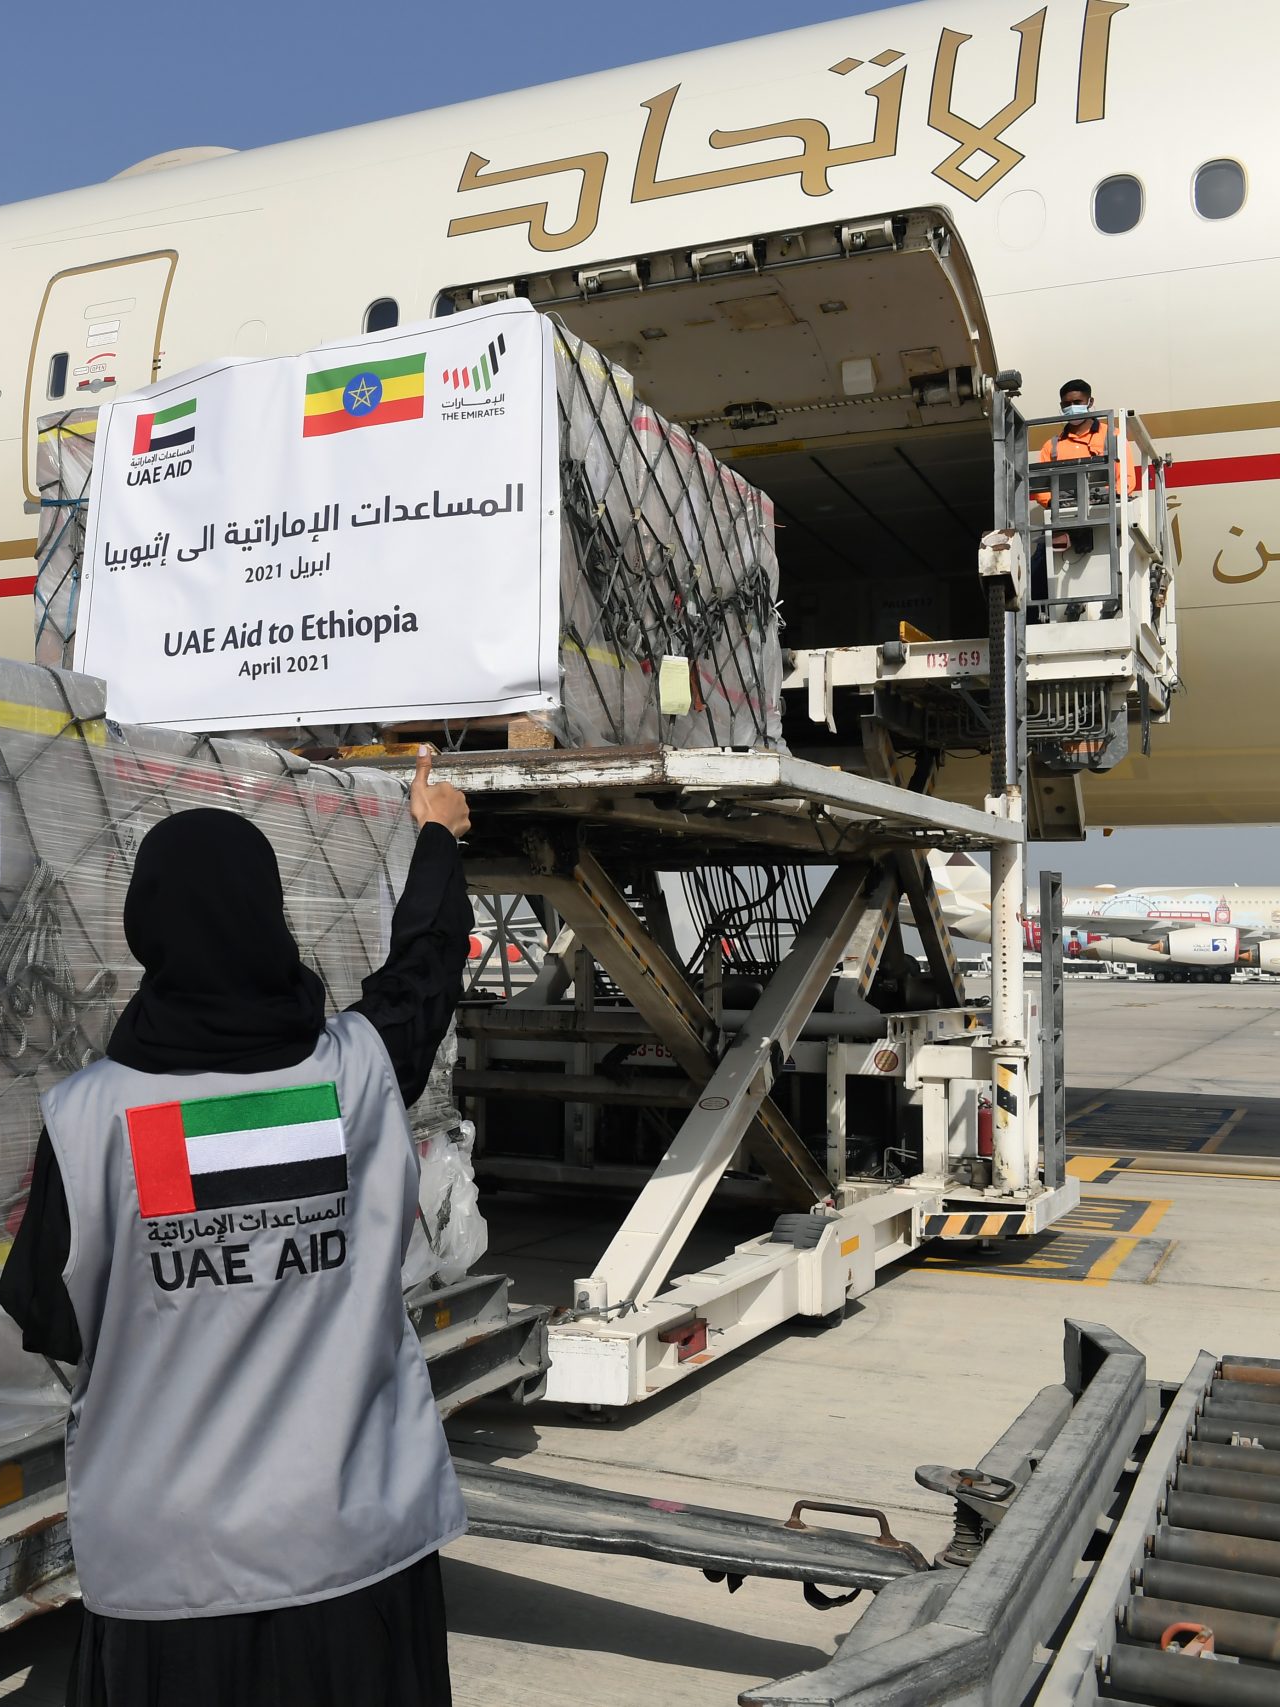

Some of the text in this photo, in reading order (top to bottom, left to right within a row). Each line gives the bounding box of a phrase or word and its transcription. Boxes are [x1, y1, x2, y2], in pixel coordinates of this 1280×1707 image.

[441, 407, 505, 421] THE EMIRATES
[158, 444, 195, 461] المساعدات
[126, 459, 192, 486] UAE AID
[104, 483, 524, 573] المساعدات الإماراتية الى إثيوبيا
[245, 553, 331, 584] ابريل 2021
[163, 605, 419, 657] UAE Aid to Ethiopia
[238, 654, 330, 681] April 2021
[147, 1196, 346, 1248] المساعدات الإماراتية
[150, 1229, 347, 1292] UAE AID
